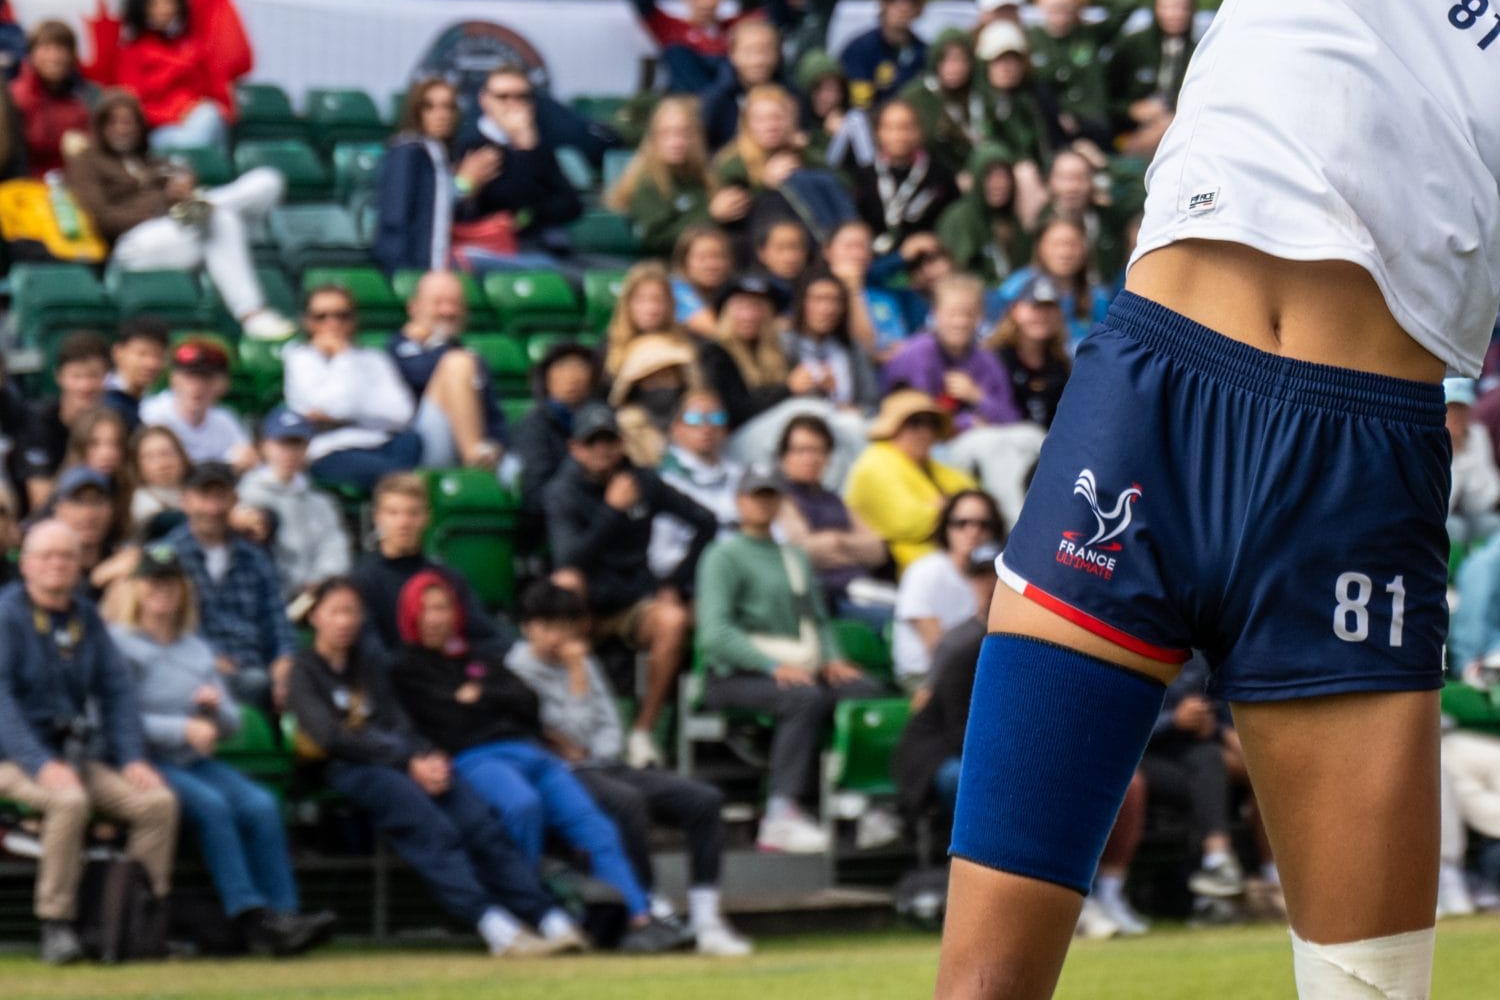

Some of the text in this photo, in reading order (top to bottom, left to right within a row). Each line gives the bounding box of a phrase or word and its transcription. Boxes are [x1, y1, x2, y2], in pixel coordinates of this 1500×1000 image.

[1055, 550, 1114, 581] ULTIMATE
[1058, 539, 1116, 572] FRANCE
[1332, 571, 1406, 648] 81
